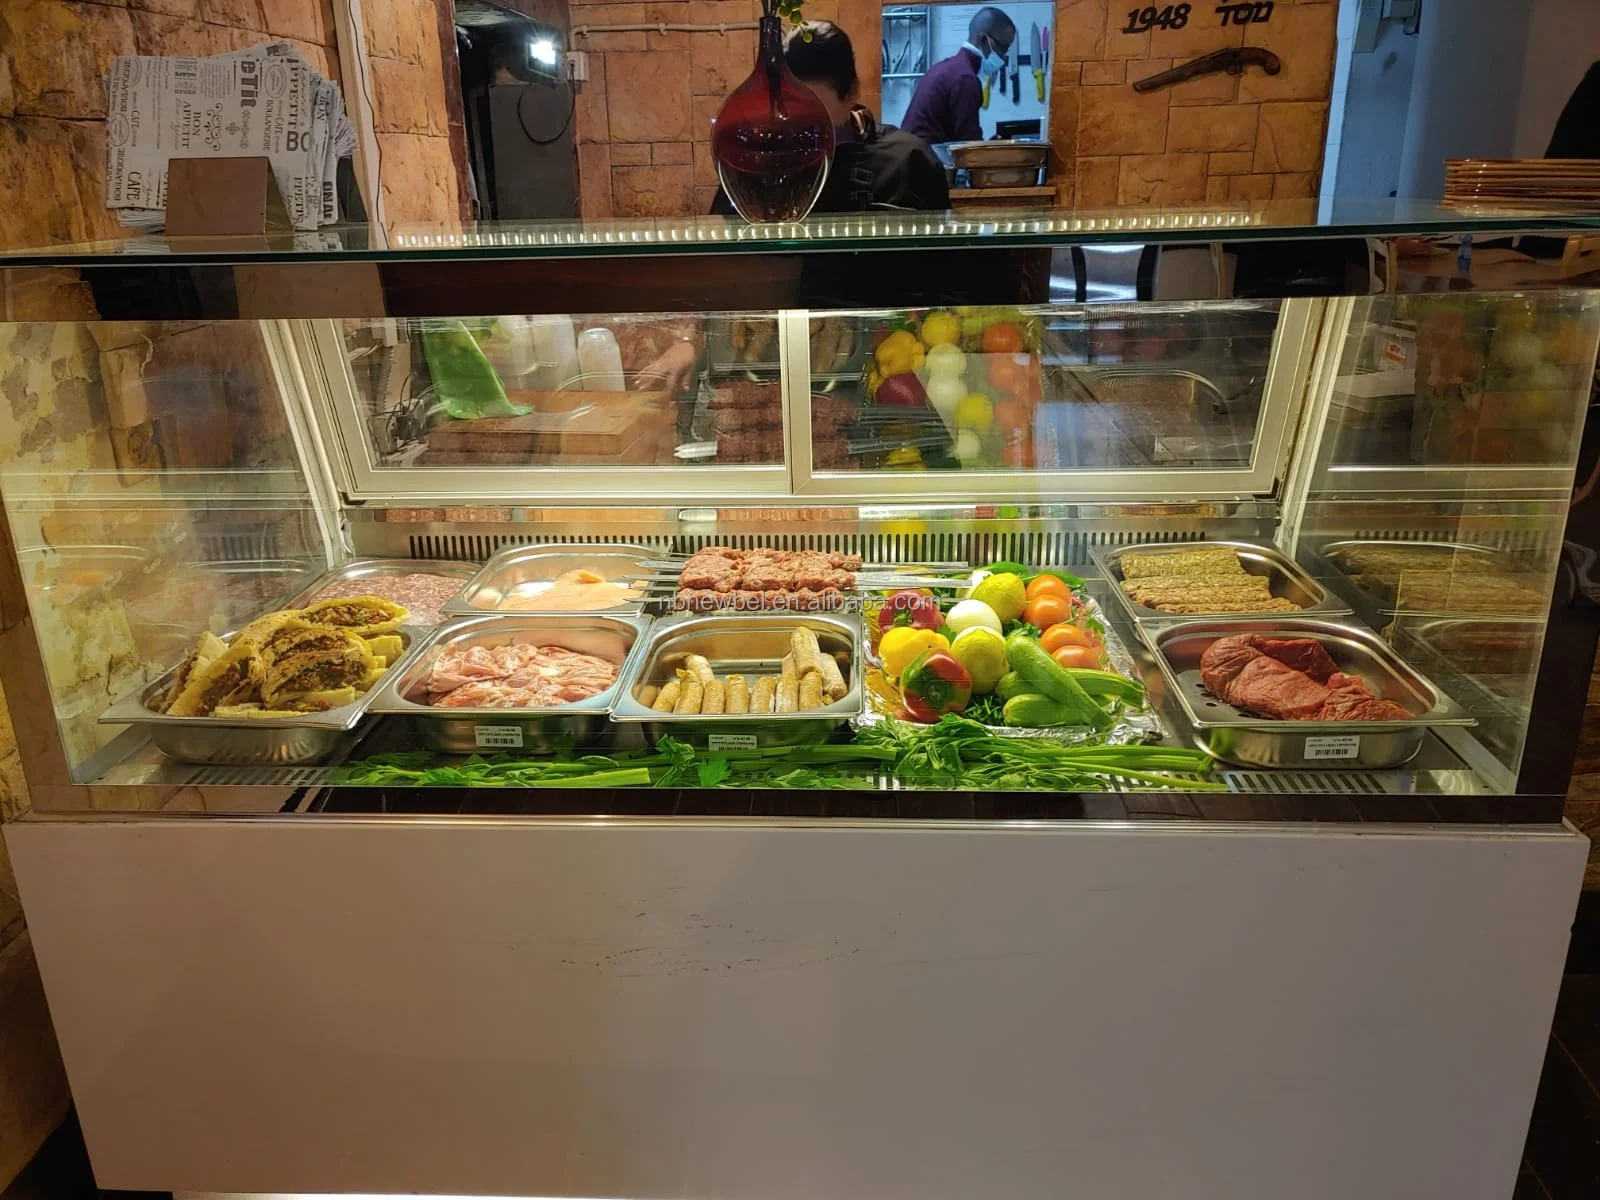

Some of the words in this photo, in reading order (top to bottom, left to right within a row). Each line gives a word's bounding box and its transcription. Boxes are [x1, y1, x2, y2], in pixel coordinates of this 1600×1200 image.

[1121, 3, 1192, 34] 1948
[181, 101, 192, 150] APPETIT
[192, 112, 202, 136] BON
[127, 171, 141, 200] CAFE
